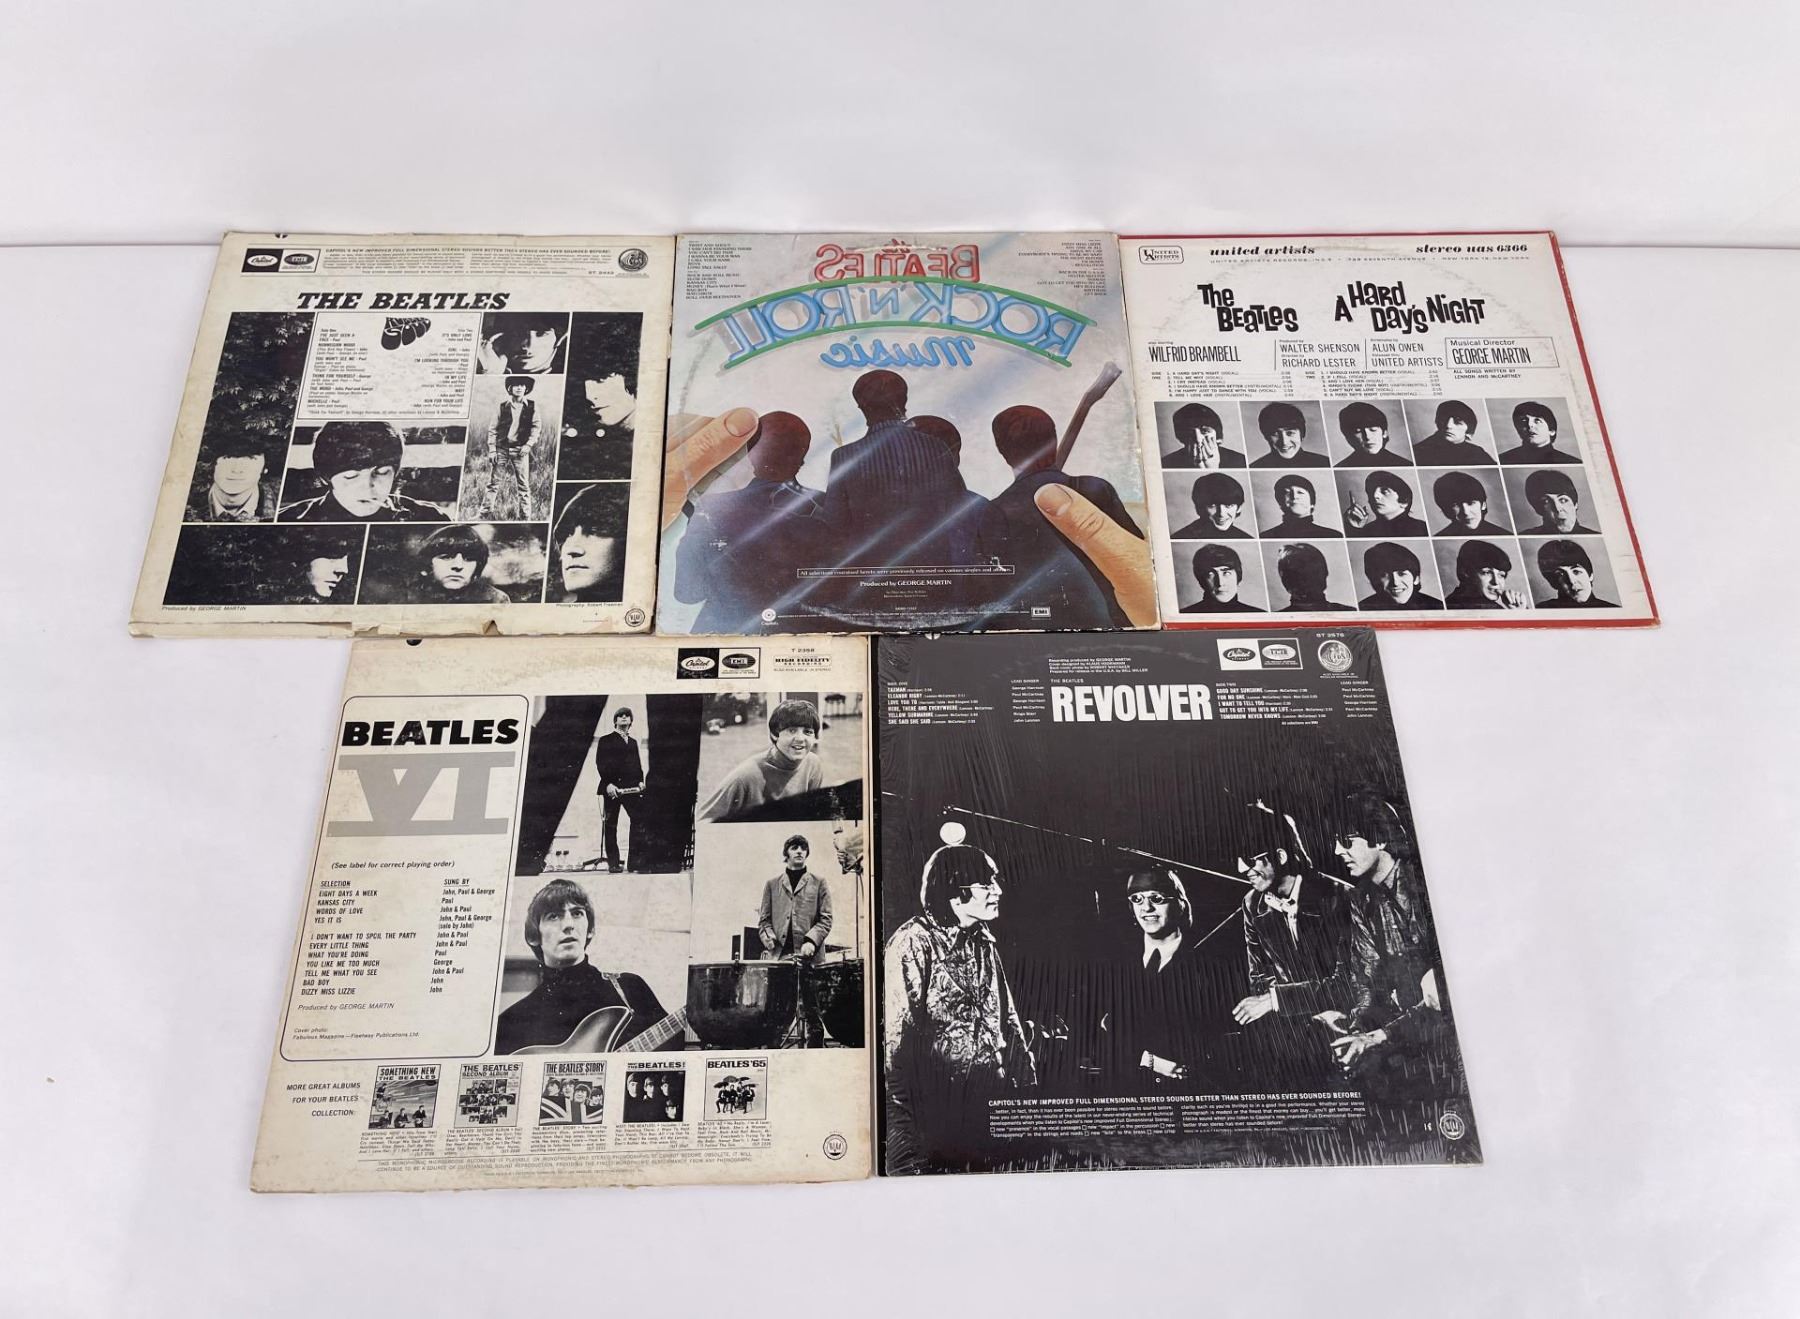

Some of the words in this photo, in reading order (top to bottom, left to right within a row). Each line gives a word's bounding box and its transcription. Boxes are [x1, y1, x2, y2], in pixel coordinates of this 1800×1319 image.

[1210, 246, 1260, 256] united
[1264, 245, 1315, 254] artists
[1416, 244, 1462, 253] stereo
[1497, 244, 1528, 252] 6366
[297, 293, 363, 309] THE
[369, 292, 510, 310] BEATLES
[1197, 283, 1234, 308] The
[1335, 295, 1353, 321] A
[1280, 344, 1314, 352] WALTER
[1318, 344, 1360, 352] SHENSON
[1372, 343, 1395, 352] ALUN
[1399, 343, 1424, 352] OWEN
[1148, 346, 1187, 362] WILFRID
[1189, 346, 1242, 362] BRAMBELL
[1452, 348, 1491, 364] GEORGE
[1492, 347, 1531, 364] MARTIN
[1282, 358, 1320, 367] RICHARD
[1324, 358, 1355, 367] LESTER
[1372, 358, 1405, 367] UNITED
[1408, 358, 1443, 366] ARTISTS
[686, 658, 710, 667] Capitol
[1051, 684, 1213, 722] REVOLVER
[342, 719, 519, 746] BEATLES
[326, 752, 515, 837] VI
[380, 1068, 418, 1076] SOMETHING
[546, 1064, 557, 1073] THE
[585, 1063, 604, 1072] STORY
